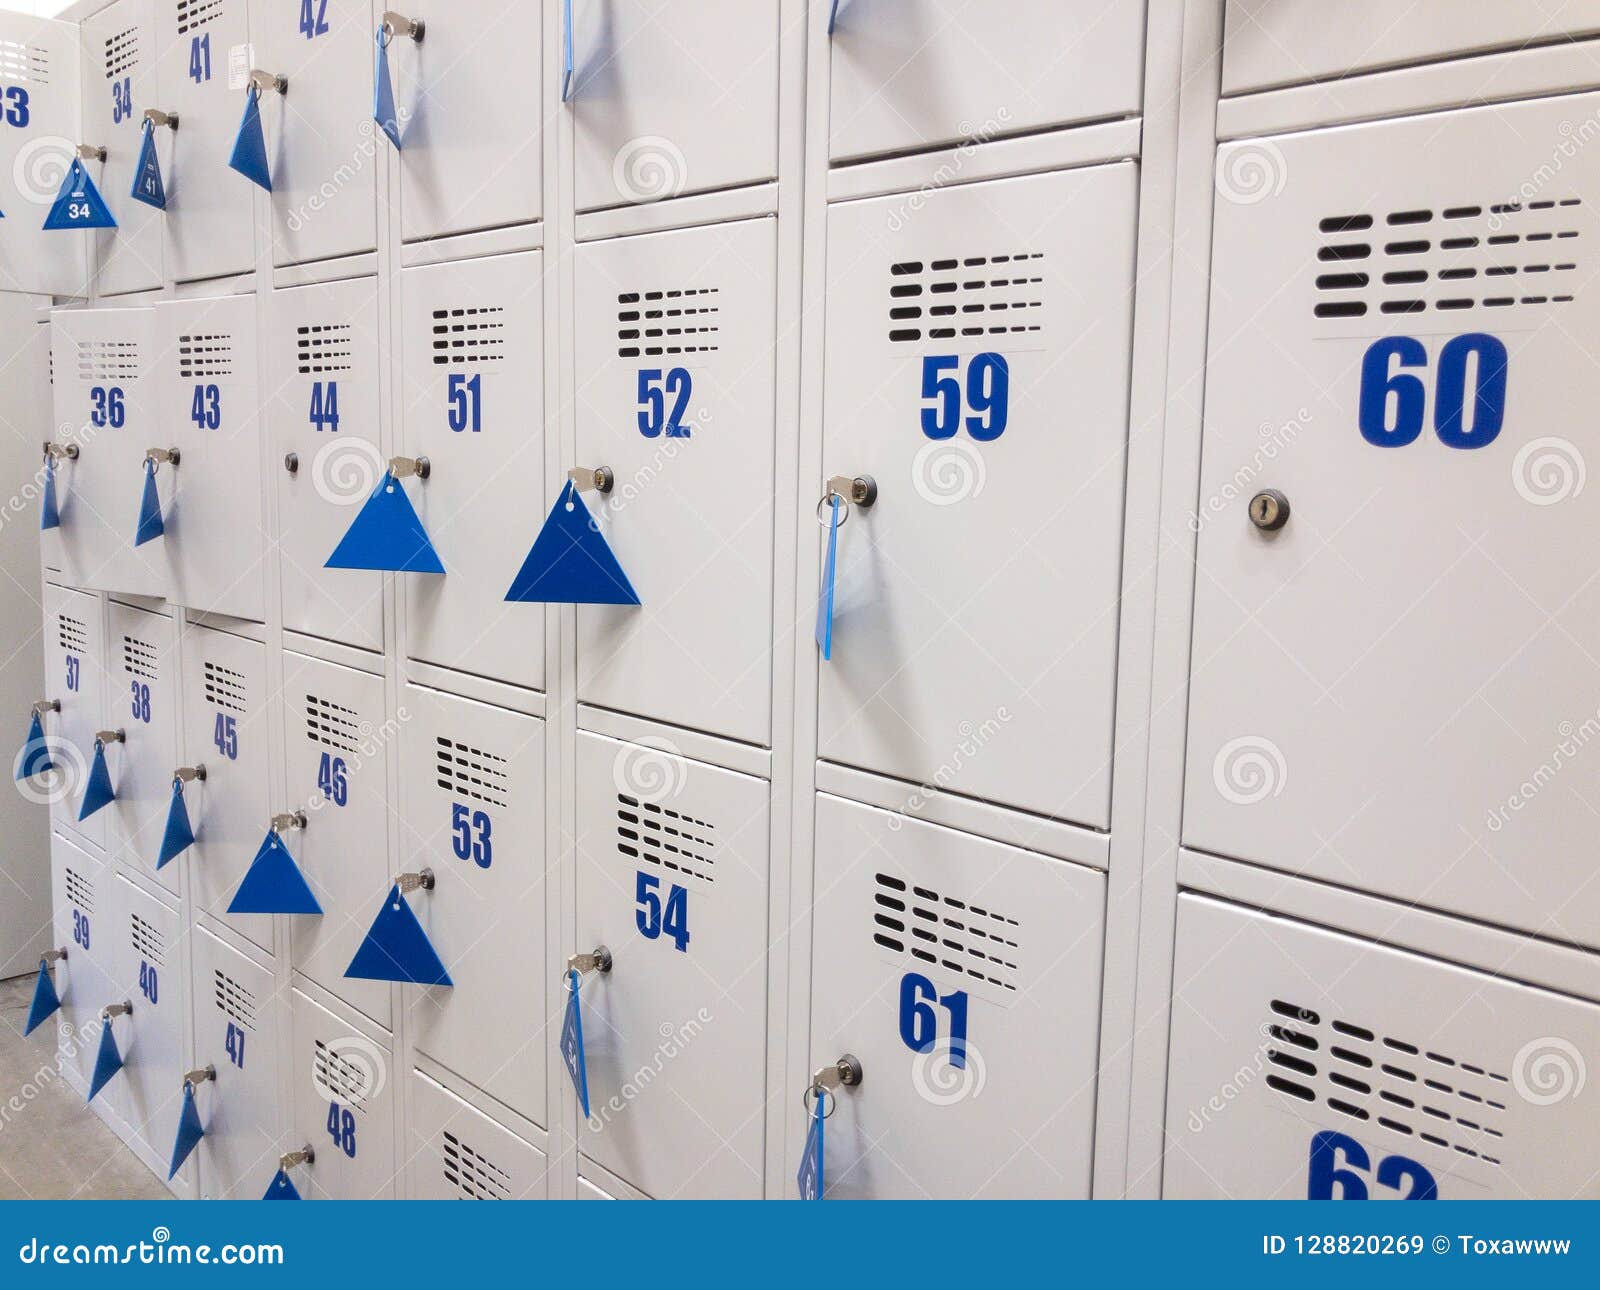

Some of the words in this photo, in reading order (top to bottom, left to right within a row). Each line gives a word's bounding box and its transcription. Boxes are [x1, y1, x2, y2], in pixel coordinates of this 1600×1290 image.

[300, 0, 328, 40] 42
[190, 32, 211, 84] 41
[0, 86, 30, 128] 3
[113, 77, 132, 124] 34
[145, 177, 156, 196] 41
[68, 203, 91, 219] 34
[90, 387, 125, 428] 36
[191, 384, 221, 430] 43
[309, 382, 339, 432] 44
[448, 374, 481, 433] 51
[637, 367, 692, 438] 52
[920, 352, 1009, 442] 59
[1359, 332, 1508, 449] 60
[66, 655, 80, 692] 37
[131, 680, 151, 723] 38
[214, 712, 238, 760] 45
[318, 752, 347, 807] 46
[452, 803, 492, 869] 53
[73, 909, 90, 950] 39
[636, 871, 691, 953] 54
[139, 961, 158, 1005] 40
[899, 972, 968, 1070] 61
[225, 1022, 245, 1069] 47
[327, 1102, 356, 1158] 48
